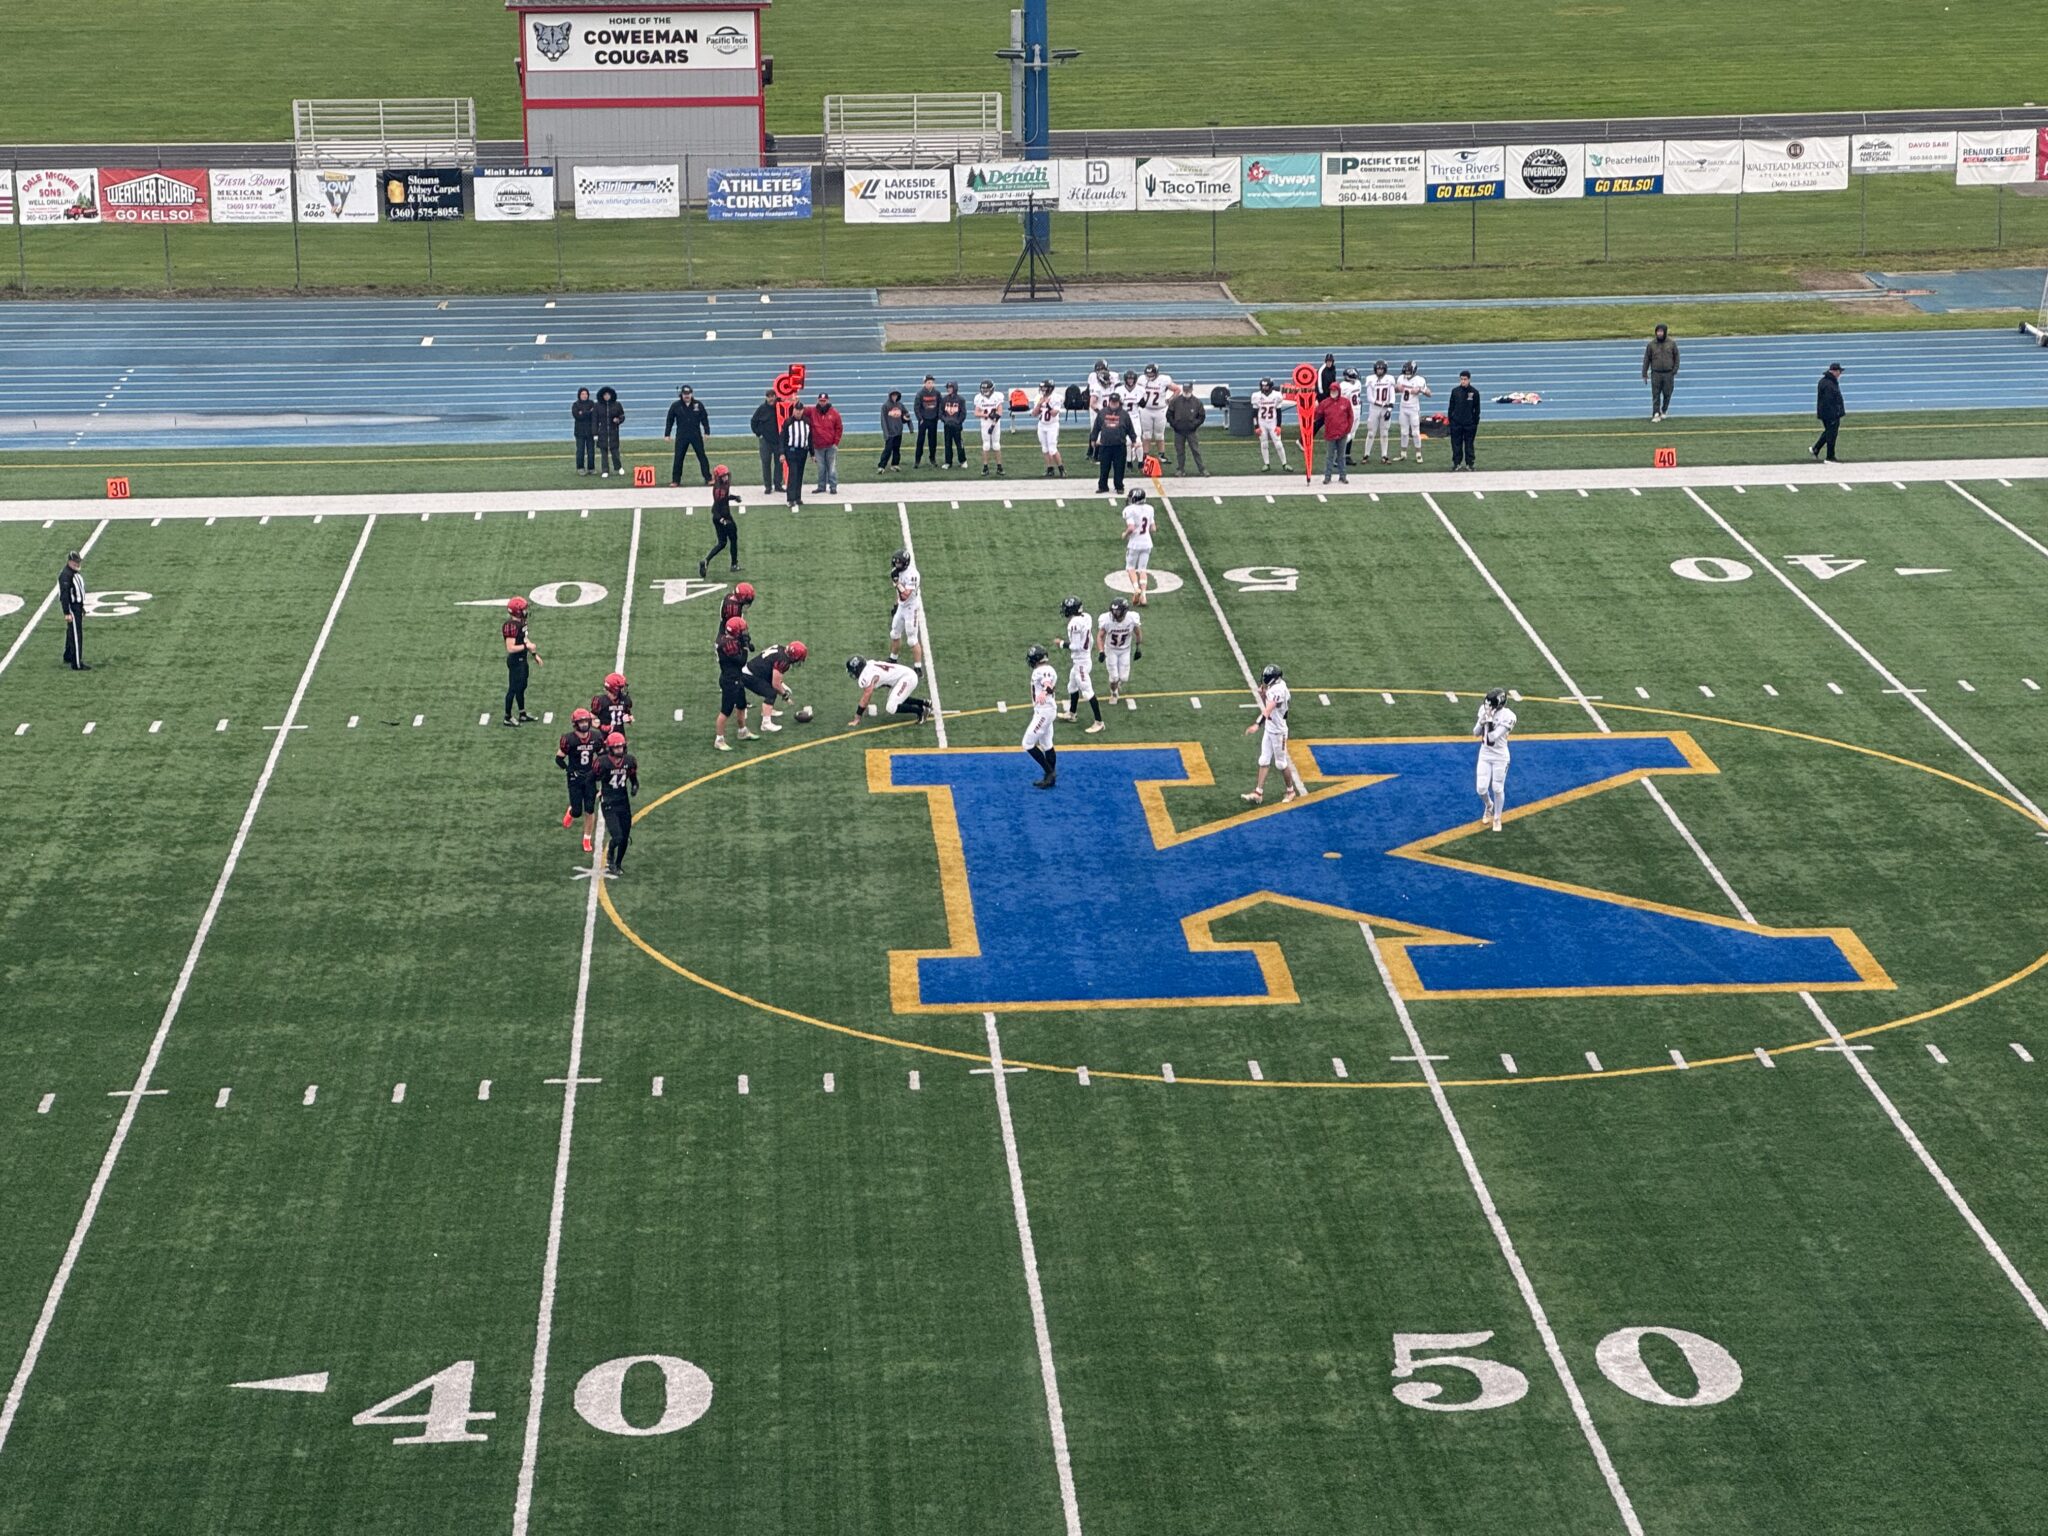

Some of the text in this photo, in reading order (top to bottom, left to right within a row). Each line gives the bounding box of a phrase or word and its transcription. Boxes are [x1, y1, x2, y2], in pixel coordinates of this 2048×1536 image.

[609, 16, 671, 25] HOME OF THE
[583, 28, 698, 46] COWEEMAN
[706, 36, 748, 45] Pacific Tech
[594, 49, 689, 65] COUGARS
[1963, 146, 2031, 156] RENAUD ELECTRIC
[1394, 156, 1420, 165] TECH
[1605, 154, 1660, 165] PeaceHealth
[484, 168, 506, 177] Minit
[508, 168, 527, 177] Mart
[1431, 162, 1500, 175] Three Rivers
[1523, 166, 1566, 177] RIVERWOODS
[1746, 162, 1790, 171] WALSTEAD
[407, 175, 439, 185] Sloans
[988, 166, 1048, 185] Denali
[1268, 174, 1316, 187] Flyways
[22, 174, 43, 193] DALE
[407, 184, 460, 195] Abbey Carpet
[598, 181, 634, 193] Stirling
[718, 178, 802, 193] ATHLETES
[884, 178, 936, 188] LAKESIDE
[1595, 179, 1610, 192] GO
[38, 188, 62, 198] SONS
[107, 178, 157, 204] WEATHER
[158, 178, 197, 204] GUARD
[884, 190, 949, 200] INDUSTRIES
[1067, 186, 1127, 200] Kilander
[1338, 191, 1407, 202] 360-414-8084
[1437, 183, 1496, 198] GO KELSO!
[407, 194, 439, 203] & Floor
[496, 194, 532, 202] LEXINGTON
[726, 195, 793, 209] CORNER
[115, 209, 194, 221] GO KELSO!
[390, 206, 459, 218] (360) 575-8055
[1375, 387, 1389, 402] 10
[1260, 407, 1275, 420] 25
[1658, 451, 1675, 466] 40
[1143, 459, 1155, 475] 50
[636, 469, 653, 485] 40
[110, 481, 128, 497] 30
[1138, 516, 1149, 535] 3
[1110, 633, 1128, 647] 55
[608, 774, 627, 790] 44
[866, 730, 1895, 1015] K
[1392, 1326, 1743, 1411] 50
[352, 1355, 713, 1444] 40
